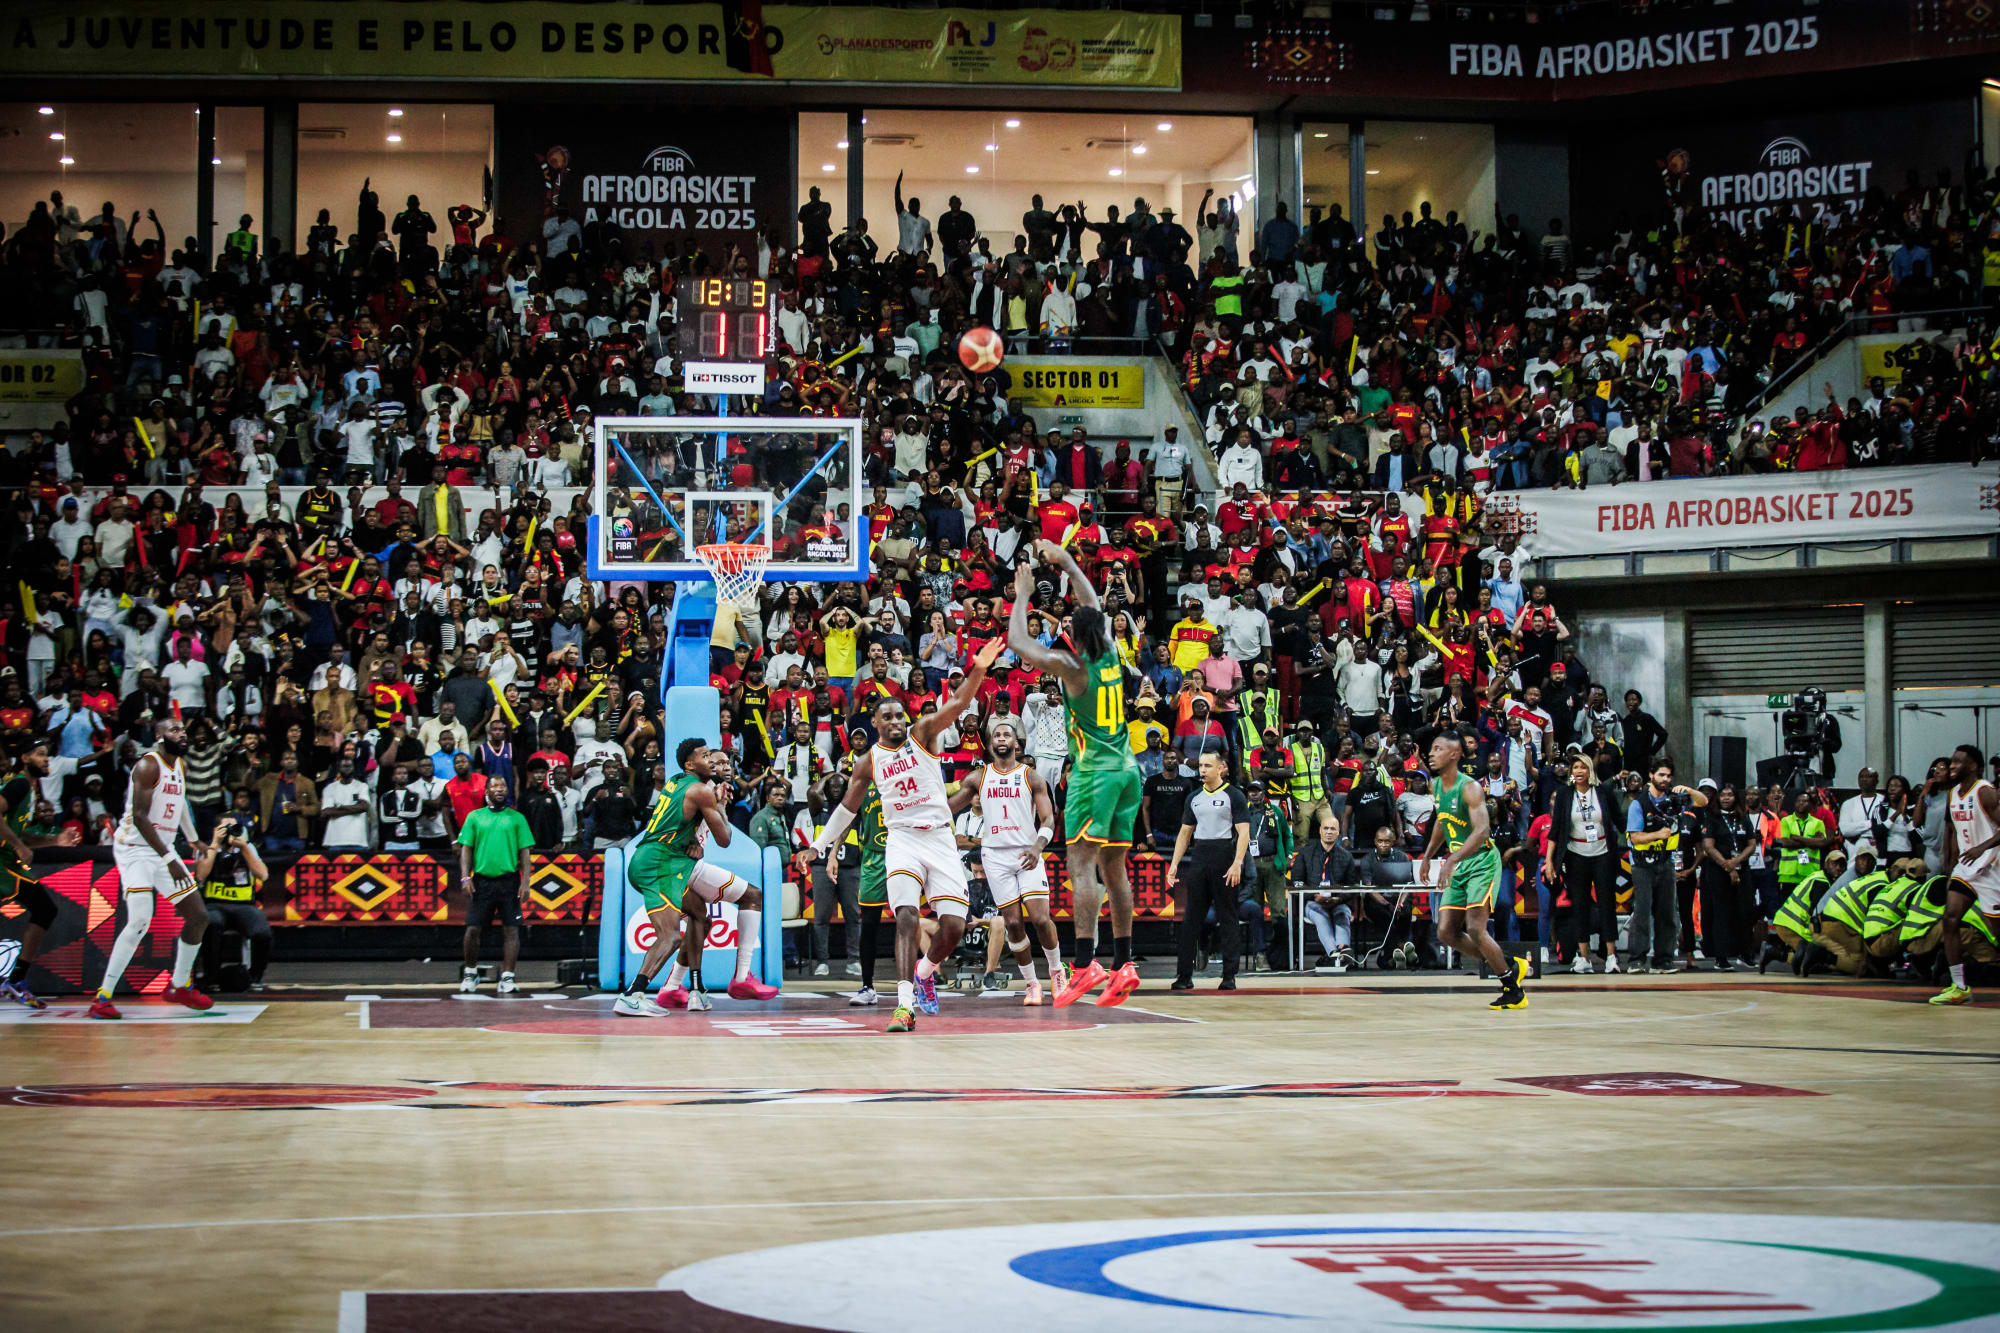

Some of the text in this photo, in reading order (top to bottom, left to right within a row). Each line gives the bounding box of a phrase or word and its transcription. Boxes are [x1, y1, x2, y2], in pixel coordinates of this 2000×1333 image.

[13, 17, 784, 55] A JUVENTUDE E PELO DESPORO
[1449, 16, 1819, 78] FIBA AFROBASKET 2025
[653, 157, 684, 172] FIBA
[1769, 148, 1800, 167] FIBA
[583, 175, 756, 203] AFROBASKET
[1701, 161, 1872, 207] AFROBASKET
[695, 209, 756, 230] 2025
[31, 364, 55, 383] 02
[711, 373, 757, 383] TISSOT
[1023, 370, 1119, 388] SECTOR 01
[1598, 488, 1914, 532] FIBA AFROBASKET 2025
[615, 541, 632, 551] FIBA
[807, 543, 847, 553] AFROBASKET
[882, 754, 919, 780] ANGOLA
[895, 776, 919, 798] 34
[987, 786, 1021, 799] ANGOLA
[163, 802, 177, 820] 15
[1002, 804, 1009, 820] 1
[1962, 828, 1971, 845] 5
